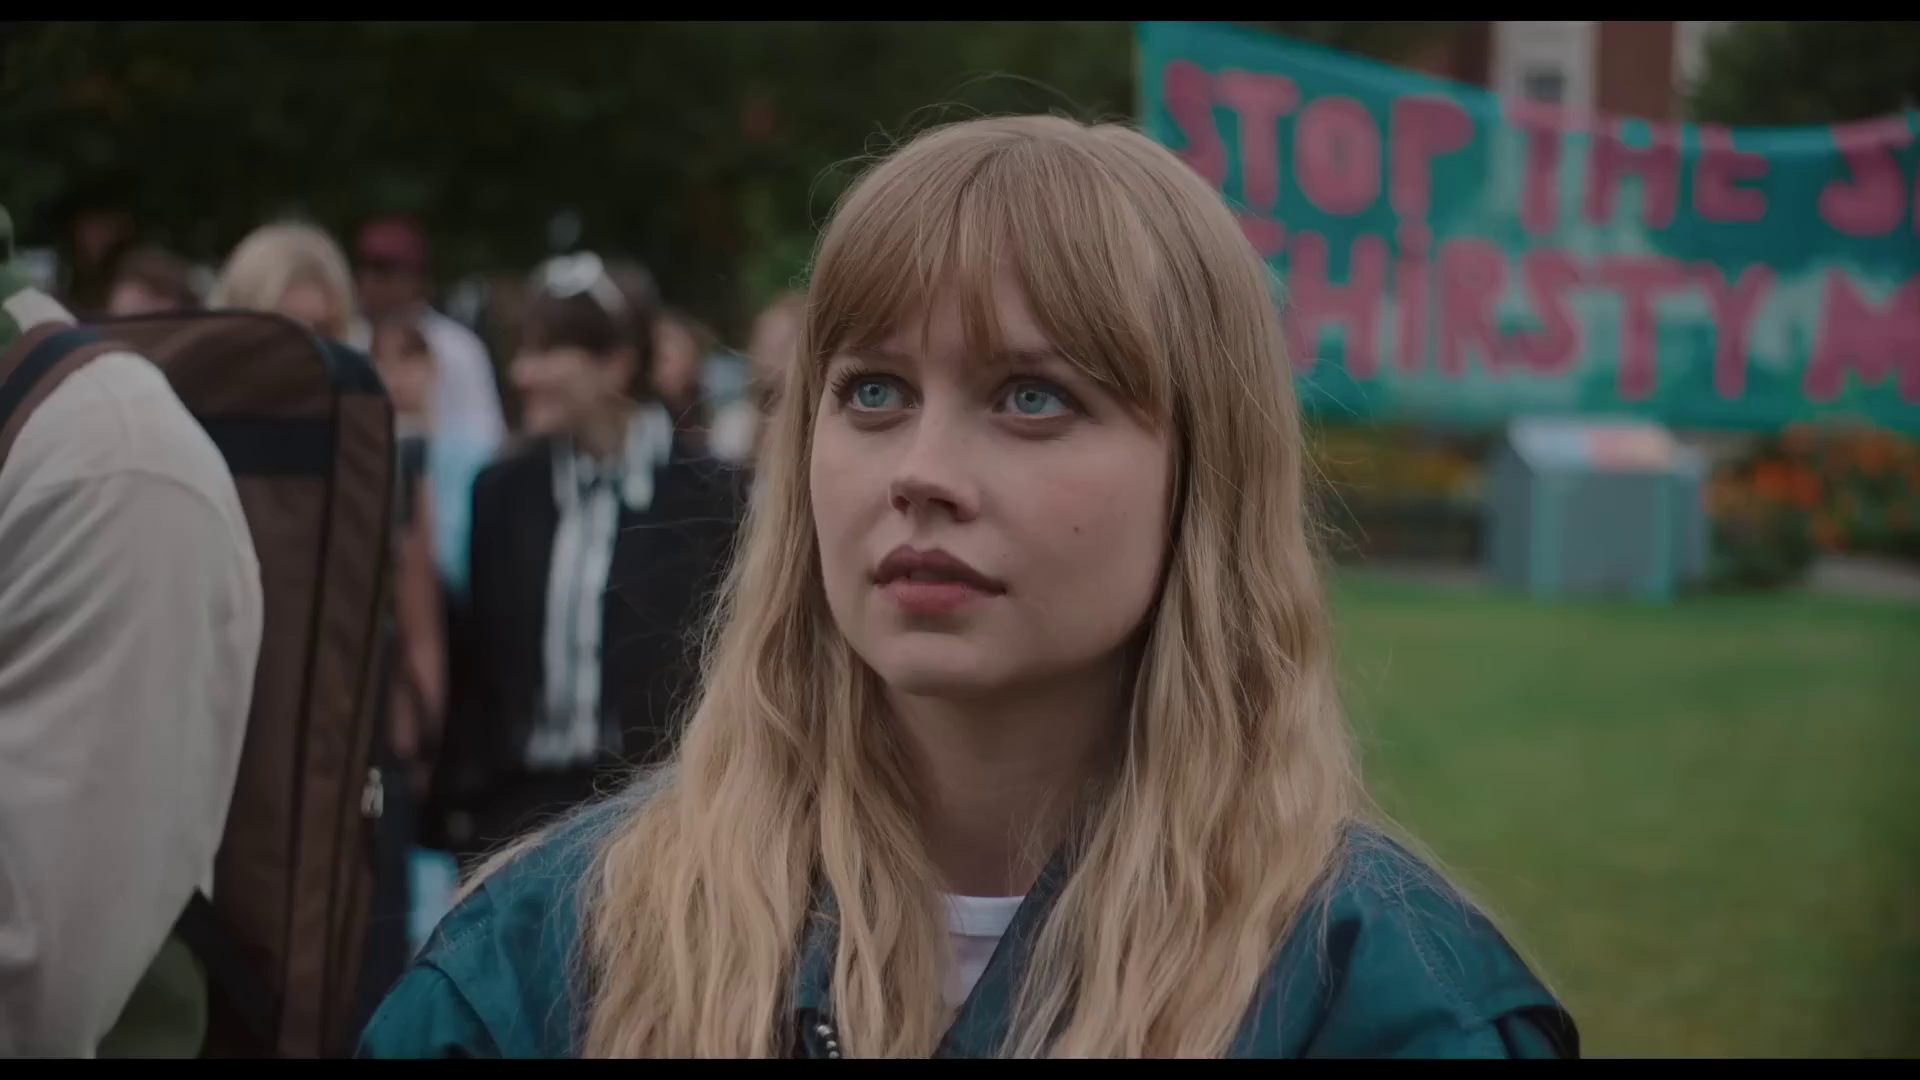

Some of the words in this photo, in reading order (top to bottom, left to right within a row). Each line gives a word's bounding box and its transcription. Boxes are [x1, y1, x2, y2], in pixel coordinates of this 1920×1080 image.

[1162, 58, 1474, 220] STOP
[1503, 97, 1769, 234] THE
[1817, 112, 1920, 238] S
